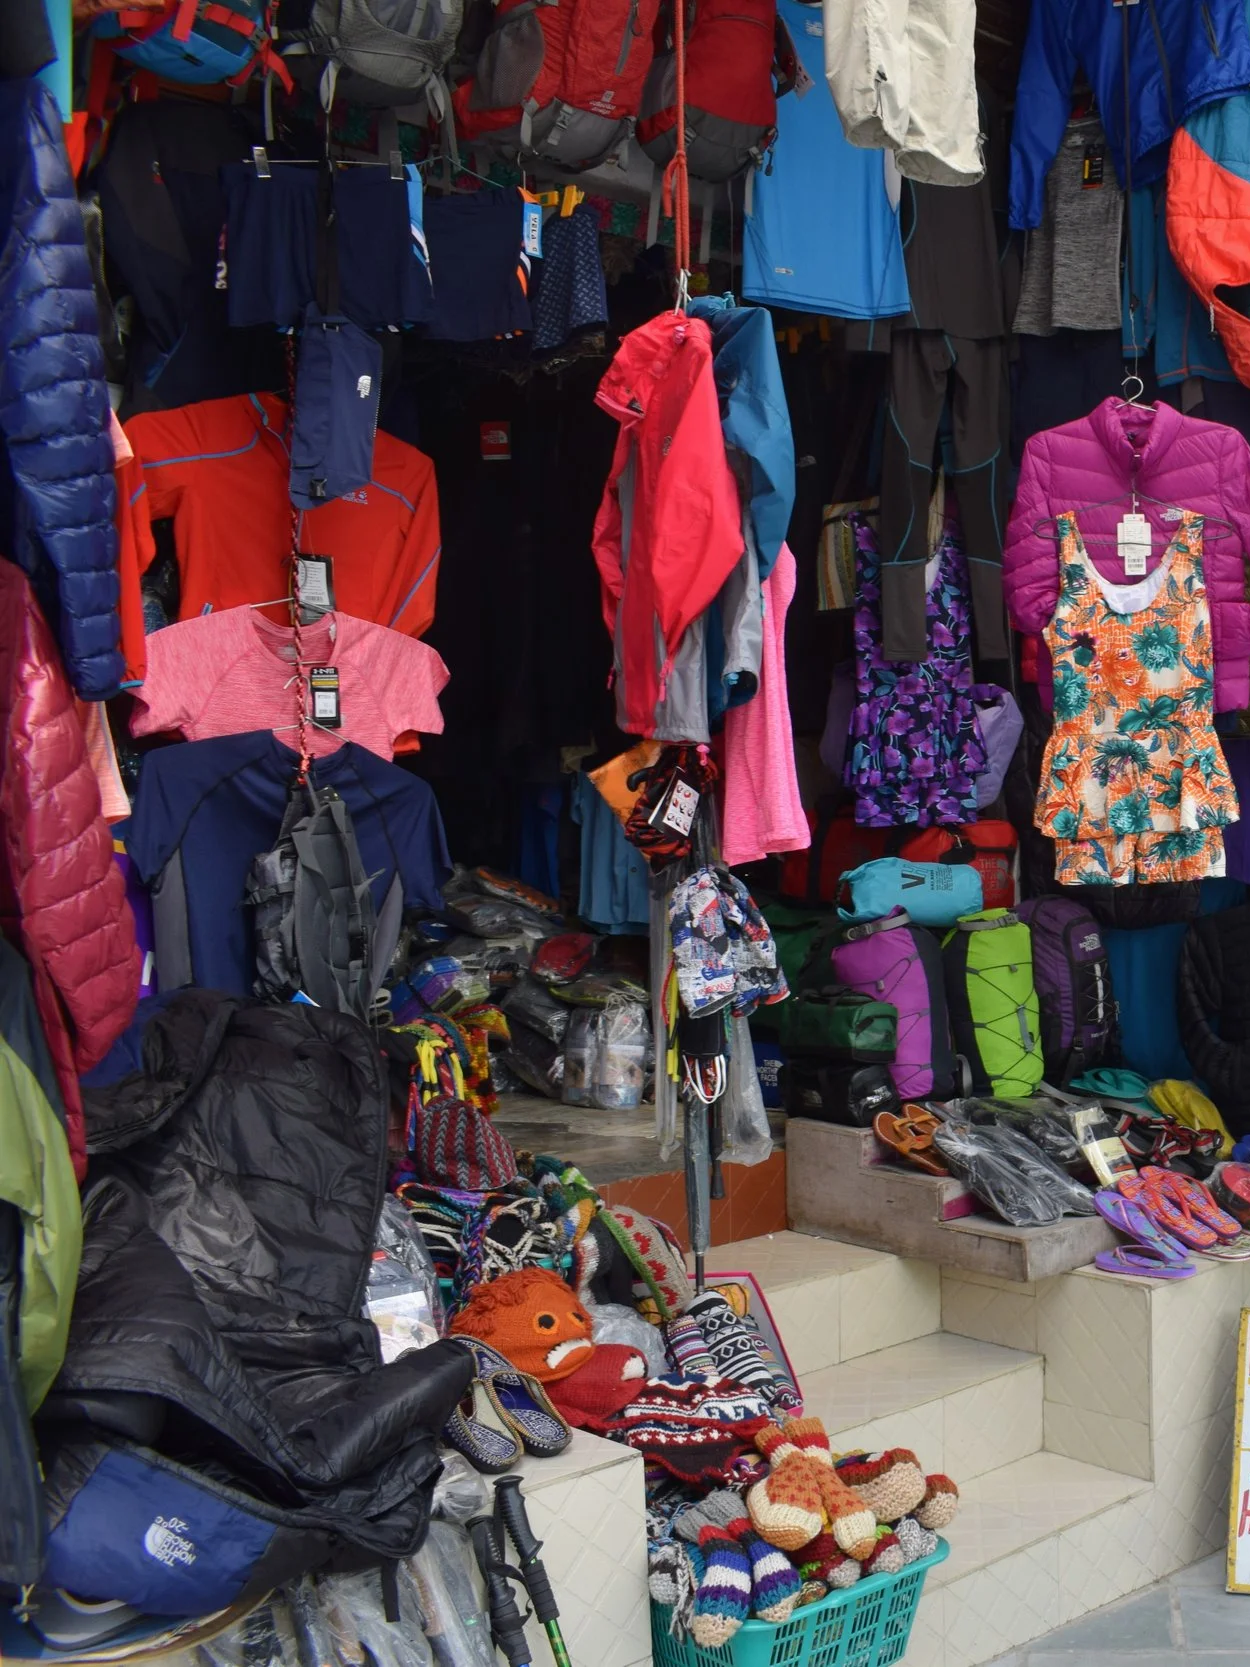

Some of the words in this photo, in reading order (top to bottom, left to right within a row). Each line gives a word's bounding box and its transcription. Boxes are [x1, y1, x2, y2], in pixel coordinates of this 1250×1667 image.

[165, 1533, 193, 1551] FACE
[156, 1550, 175, 1567] THE
[160, 1539, 197, 1565] NORTH
